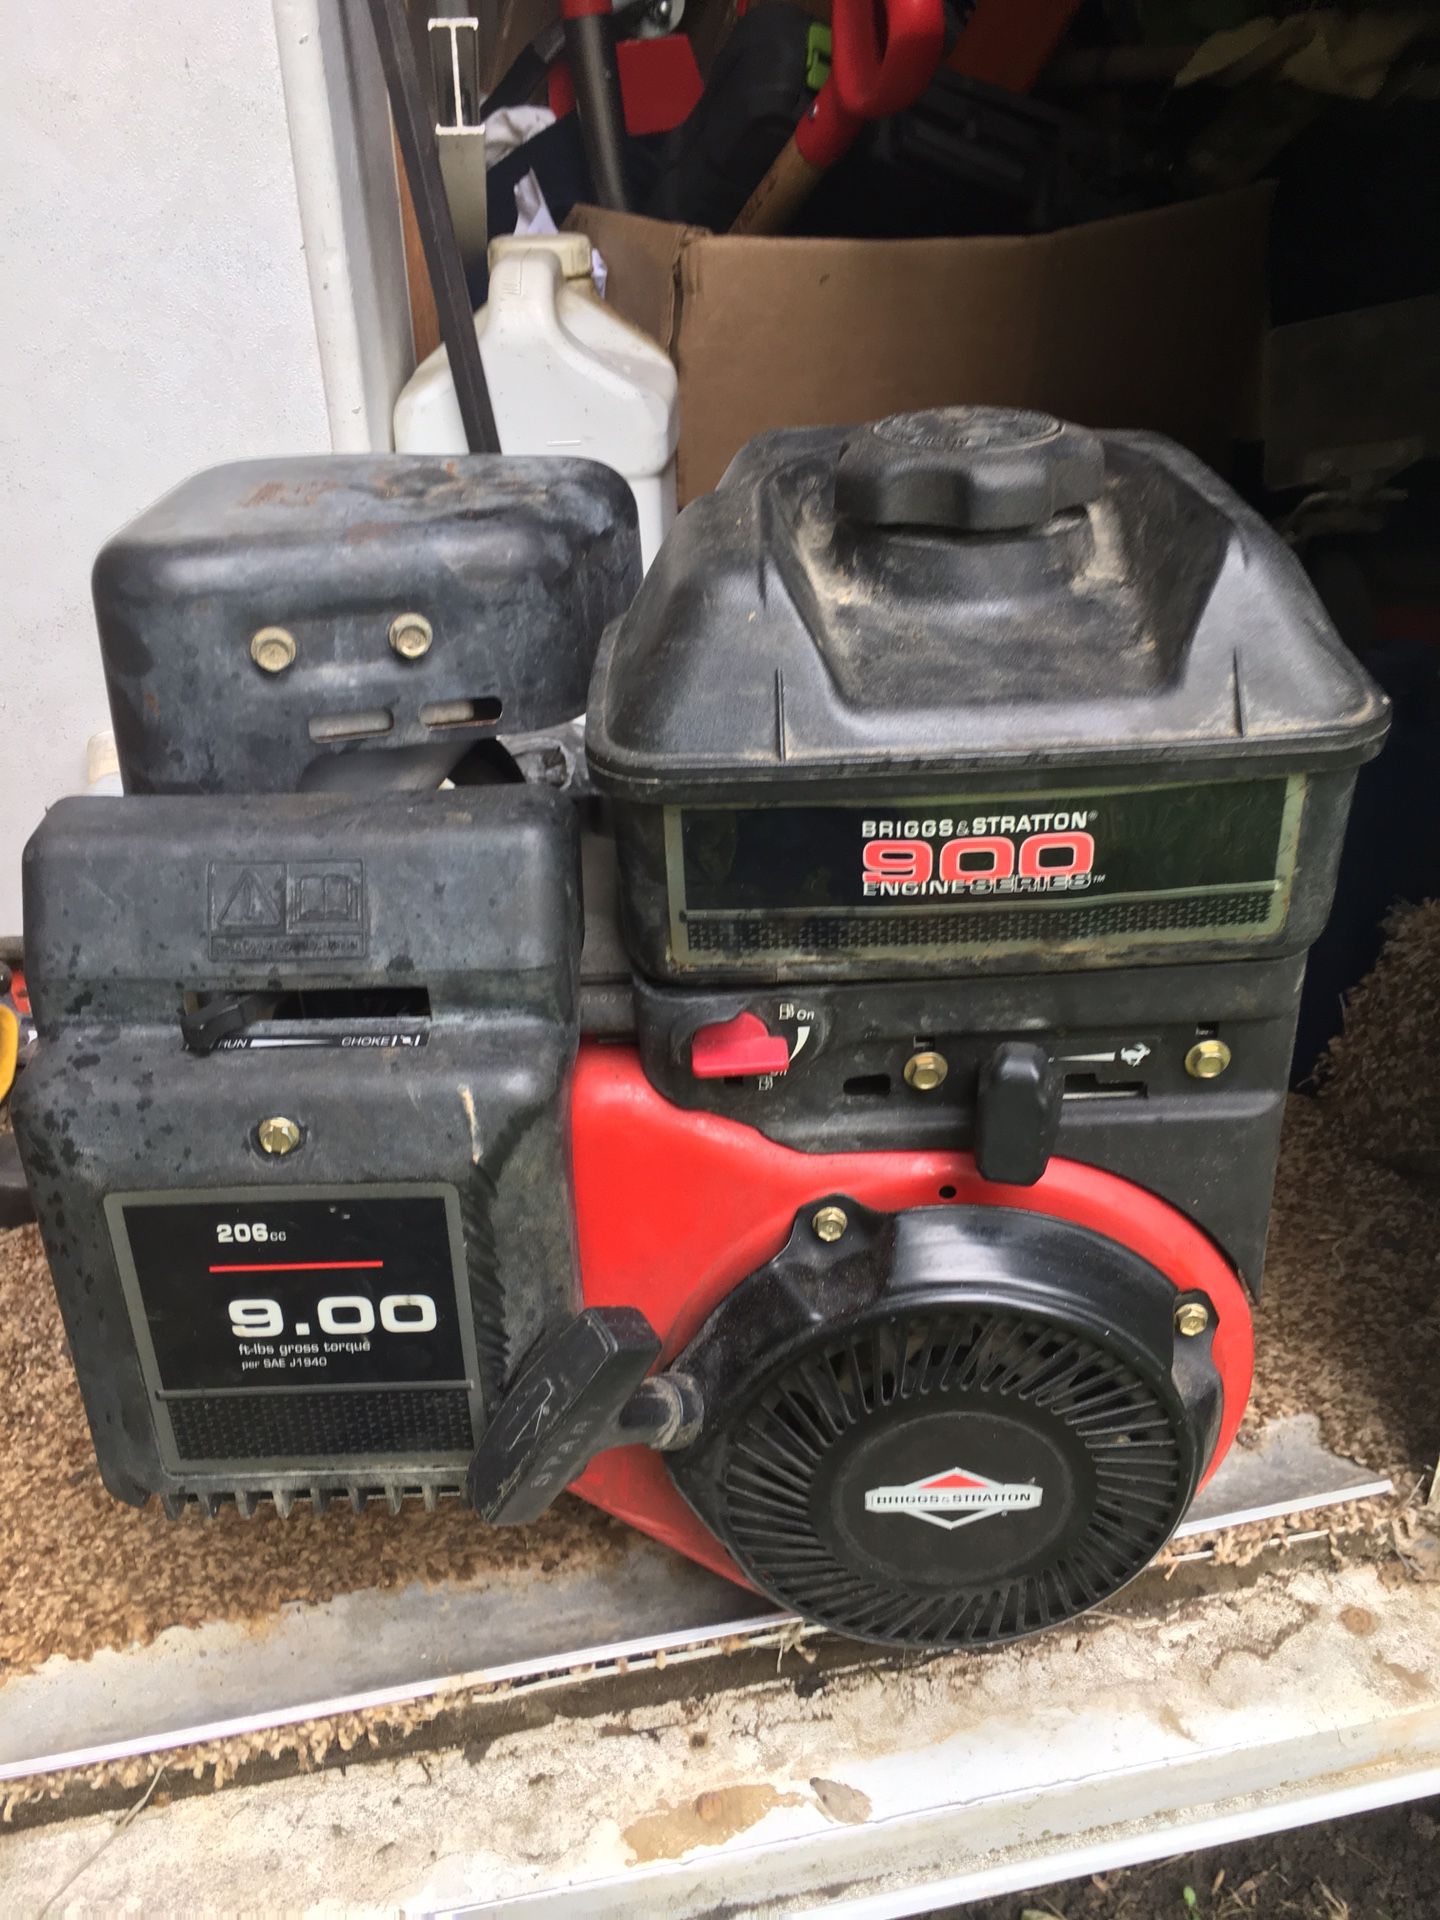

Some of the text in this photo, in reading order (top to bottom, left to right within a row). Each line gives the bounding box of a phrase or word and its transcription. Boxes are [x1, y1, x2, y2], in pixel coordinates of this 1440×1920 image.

[862, 831, 1095, 884] 900
[796, 1009, 815, 1021] On
[341, 1035, 390, 1047] CHOKE
[228, 1294, 437, 1337] 9.00
[279, 1343, 319, 1357] gross
[323, 1340, 371, 1355] torque
[241, 1360, 261, 1372] per
[263, 1358, 286, 1368] SAE
